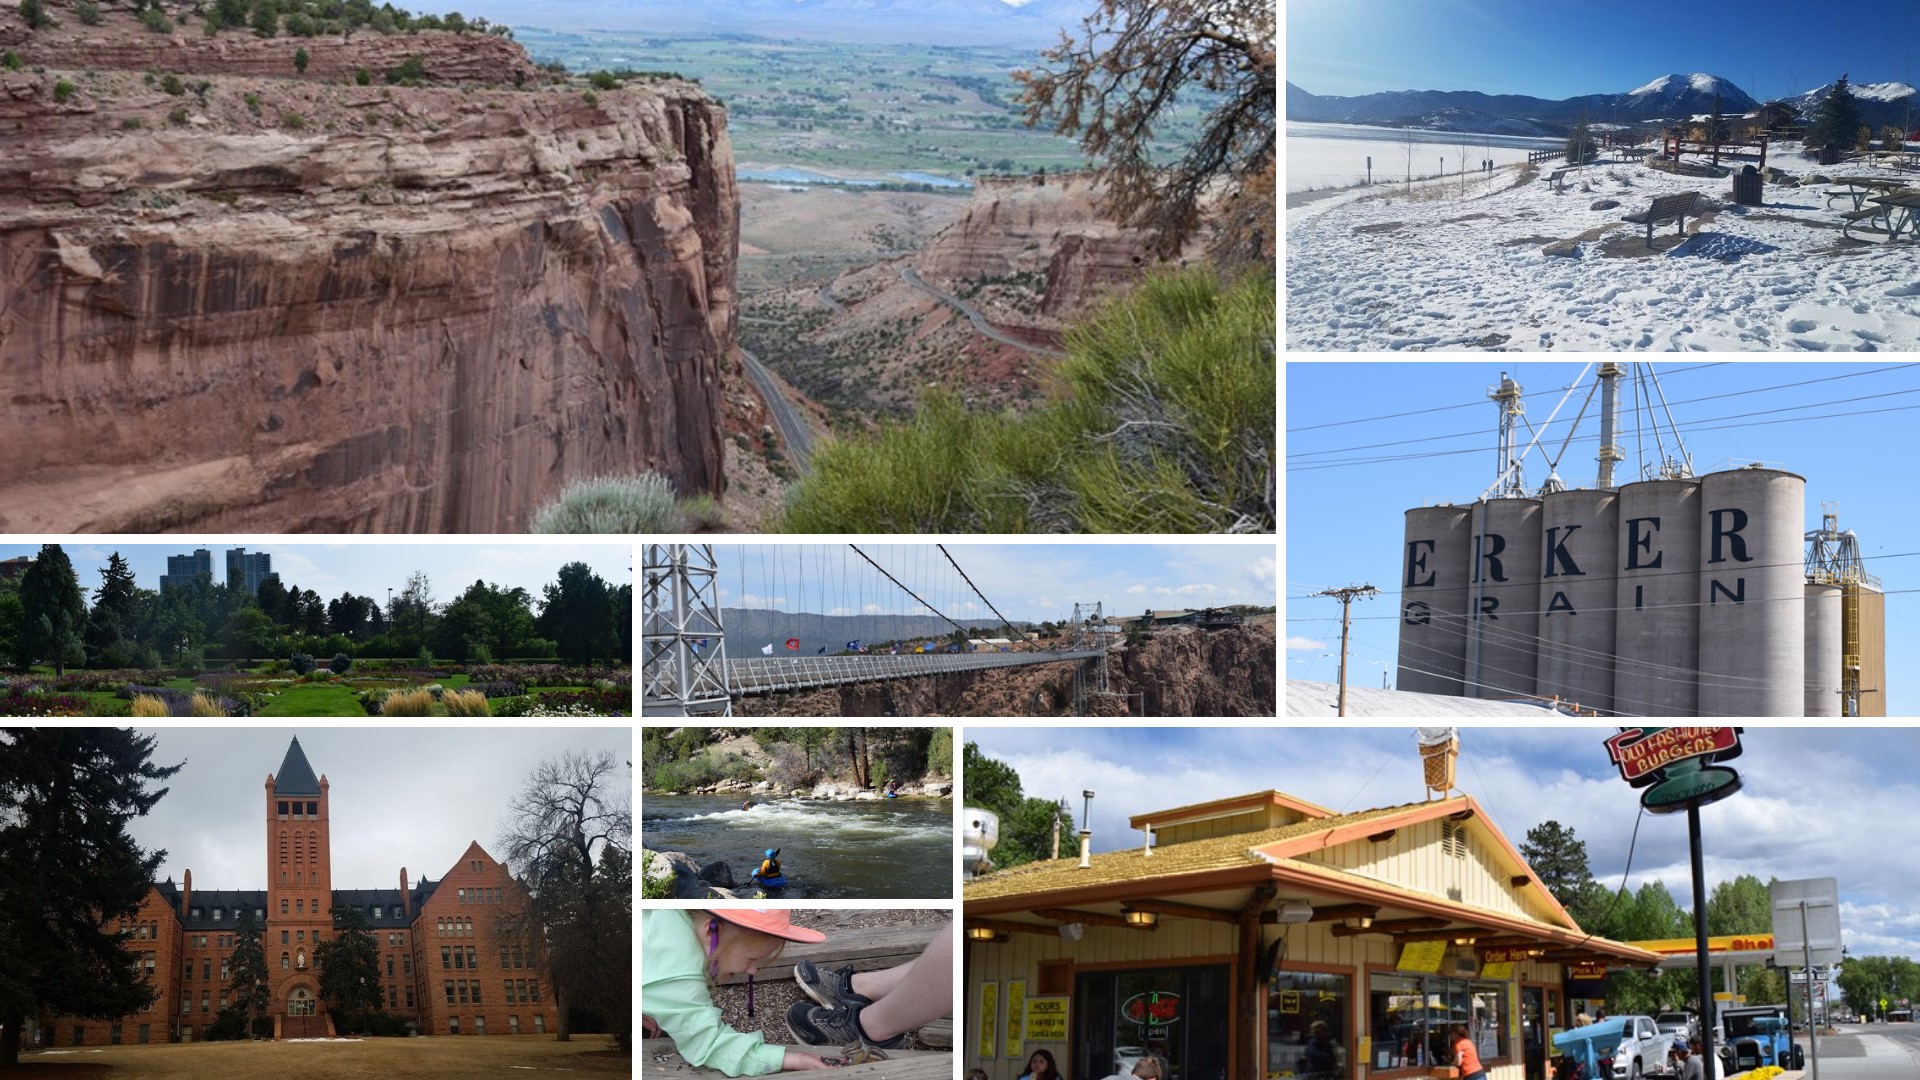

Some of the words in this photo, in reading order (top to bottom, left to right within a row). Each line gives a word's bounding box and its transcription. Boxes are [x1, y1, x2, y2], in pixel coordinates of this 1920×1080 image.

[1405, 508, 1753, 588] ERKER
[1404, 577, 1745, 626] GRAIN
[1622, 743, 1645, 762] OLD
[1648, 727, 1721, 751] FASHIONED
[1637, 736, 1715, 772] BURGERS
[1485, 950, 1507, 962] Order
[1509, 949, 1528, 961] Here
[1732, 938, 1774, 950] Shel
[1572, 966, 1590, 974] Pick
[1593, 966, 1606, 975] Up
[1034, 1001, 1060, 1011] HOURS
